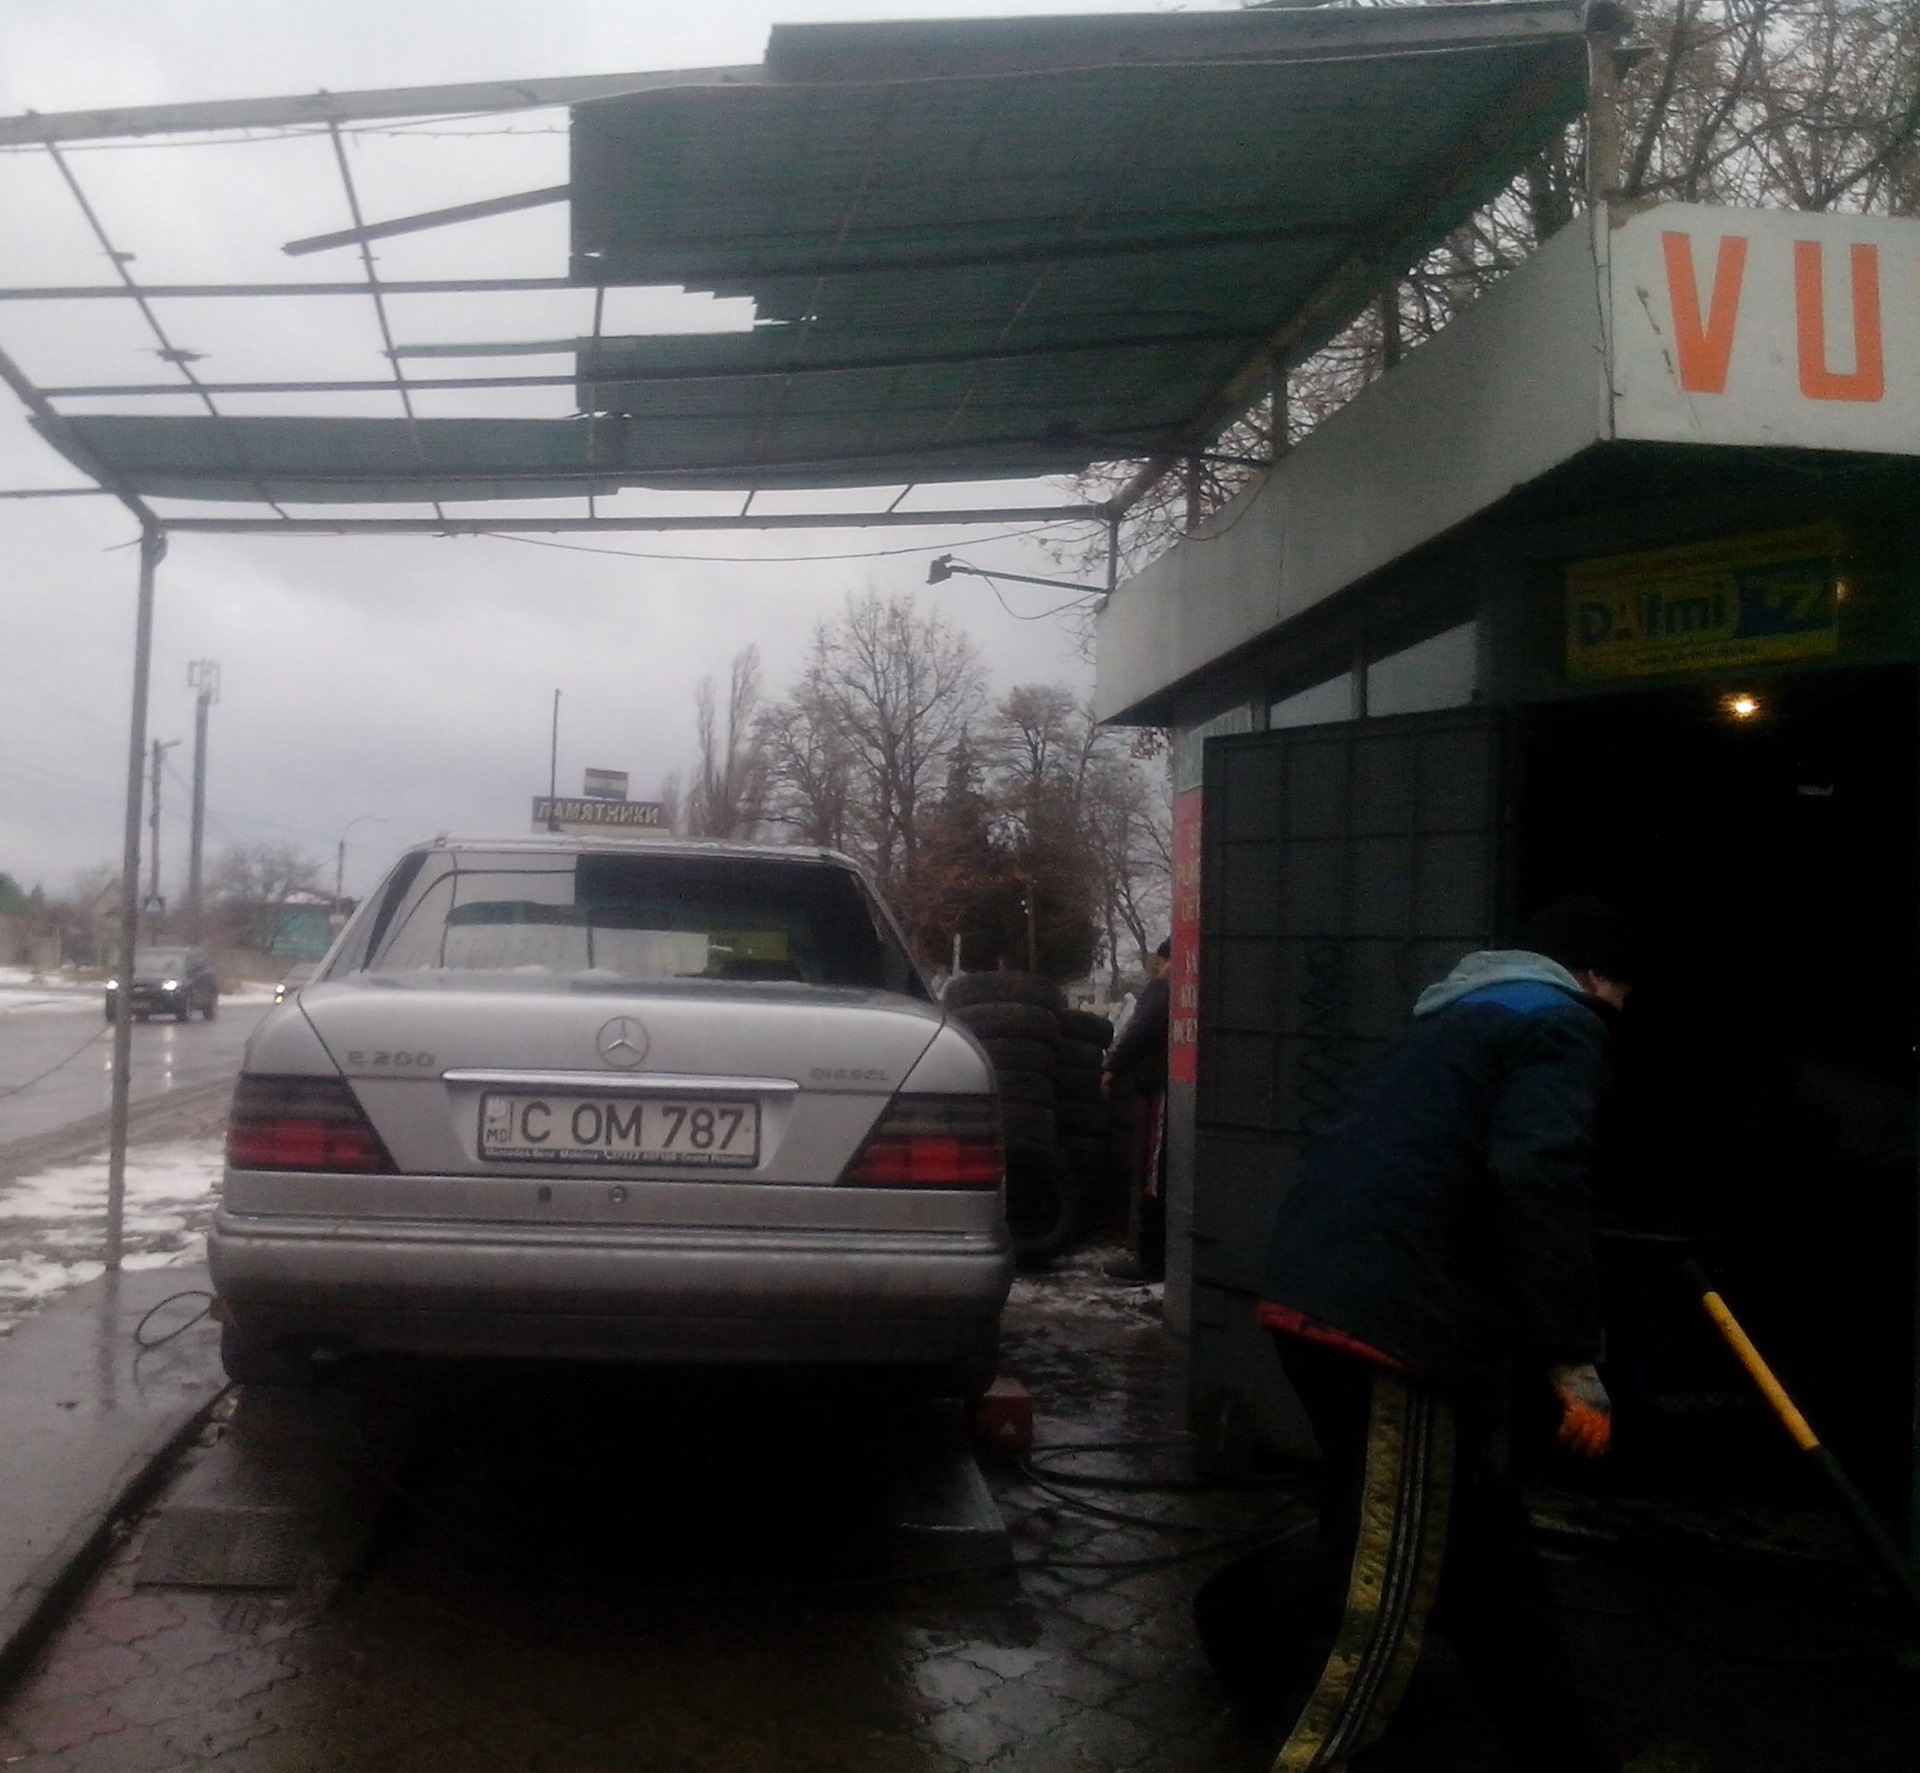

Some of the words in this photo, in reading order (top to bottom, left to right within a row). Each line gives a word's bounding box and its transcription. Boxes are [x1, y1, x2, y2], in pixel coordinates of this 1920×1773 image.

[538, 801, 660, 824] ПАМЯТНИКИ
[374, 1051, 436, 1067] 200
[521, 1101, 551, 1142] C
[572, 1103, 643, 1147] OM
[662, 1106, 744, 1150] 787
[486, 1128, 508, 1143] MD
